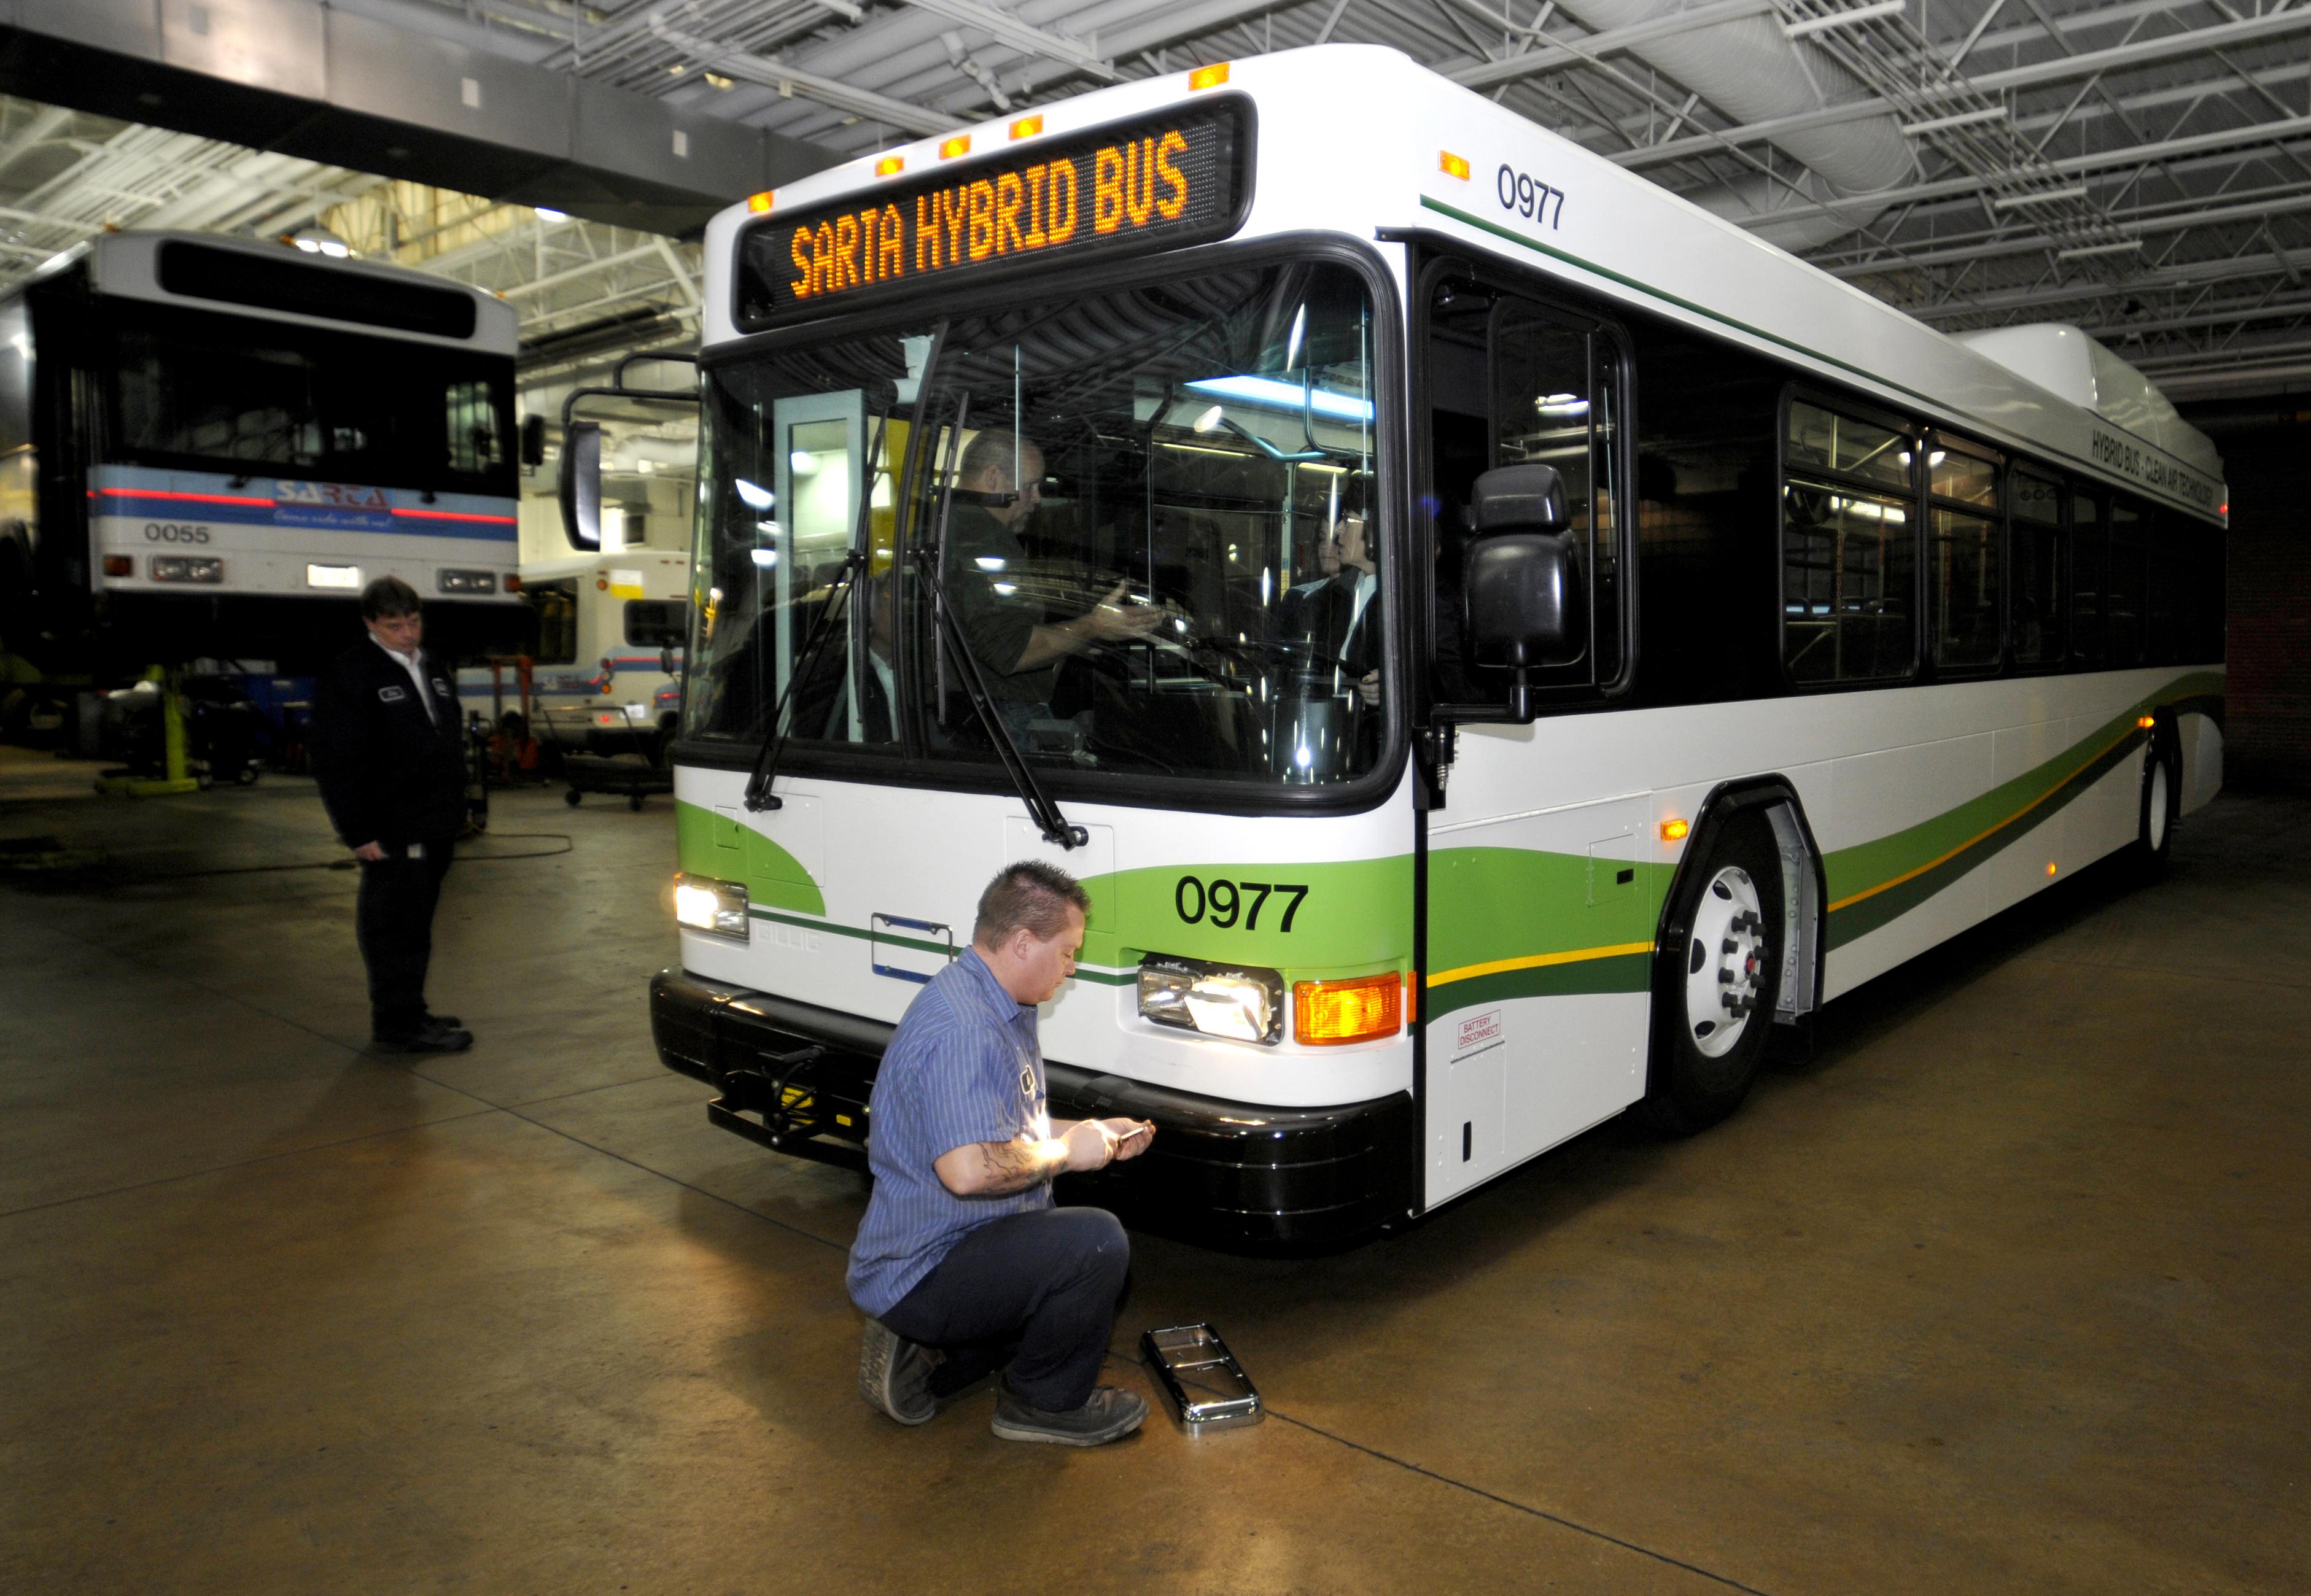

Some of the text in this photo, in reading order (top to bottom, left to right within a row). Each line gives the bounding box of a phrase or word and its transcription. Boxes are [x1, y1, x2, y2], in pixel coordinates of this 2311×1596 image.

[791, 130, 1187, 298] SARTA HYBRID BUS
[1497, 163, 1564, 230] 0977
[2092, 430, 2123, 468] HYBRID
[2124, 445, 2140, 476] BUS
[145, 523, 209, 544] 0055
[1175, 875, 1308, 932] 0977
[1460, 1023, 1499, 1046] DISCONNECT
[1463, 1016, 1491, 1033] BATTERY
